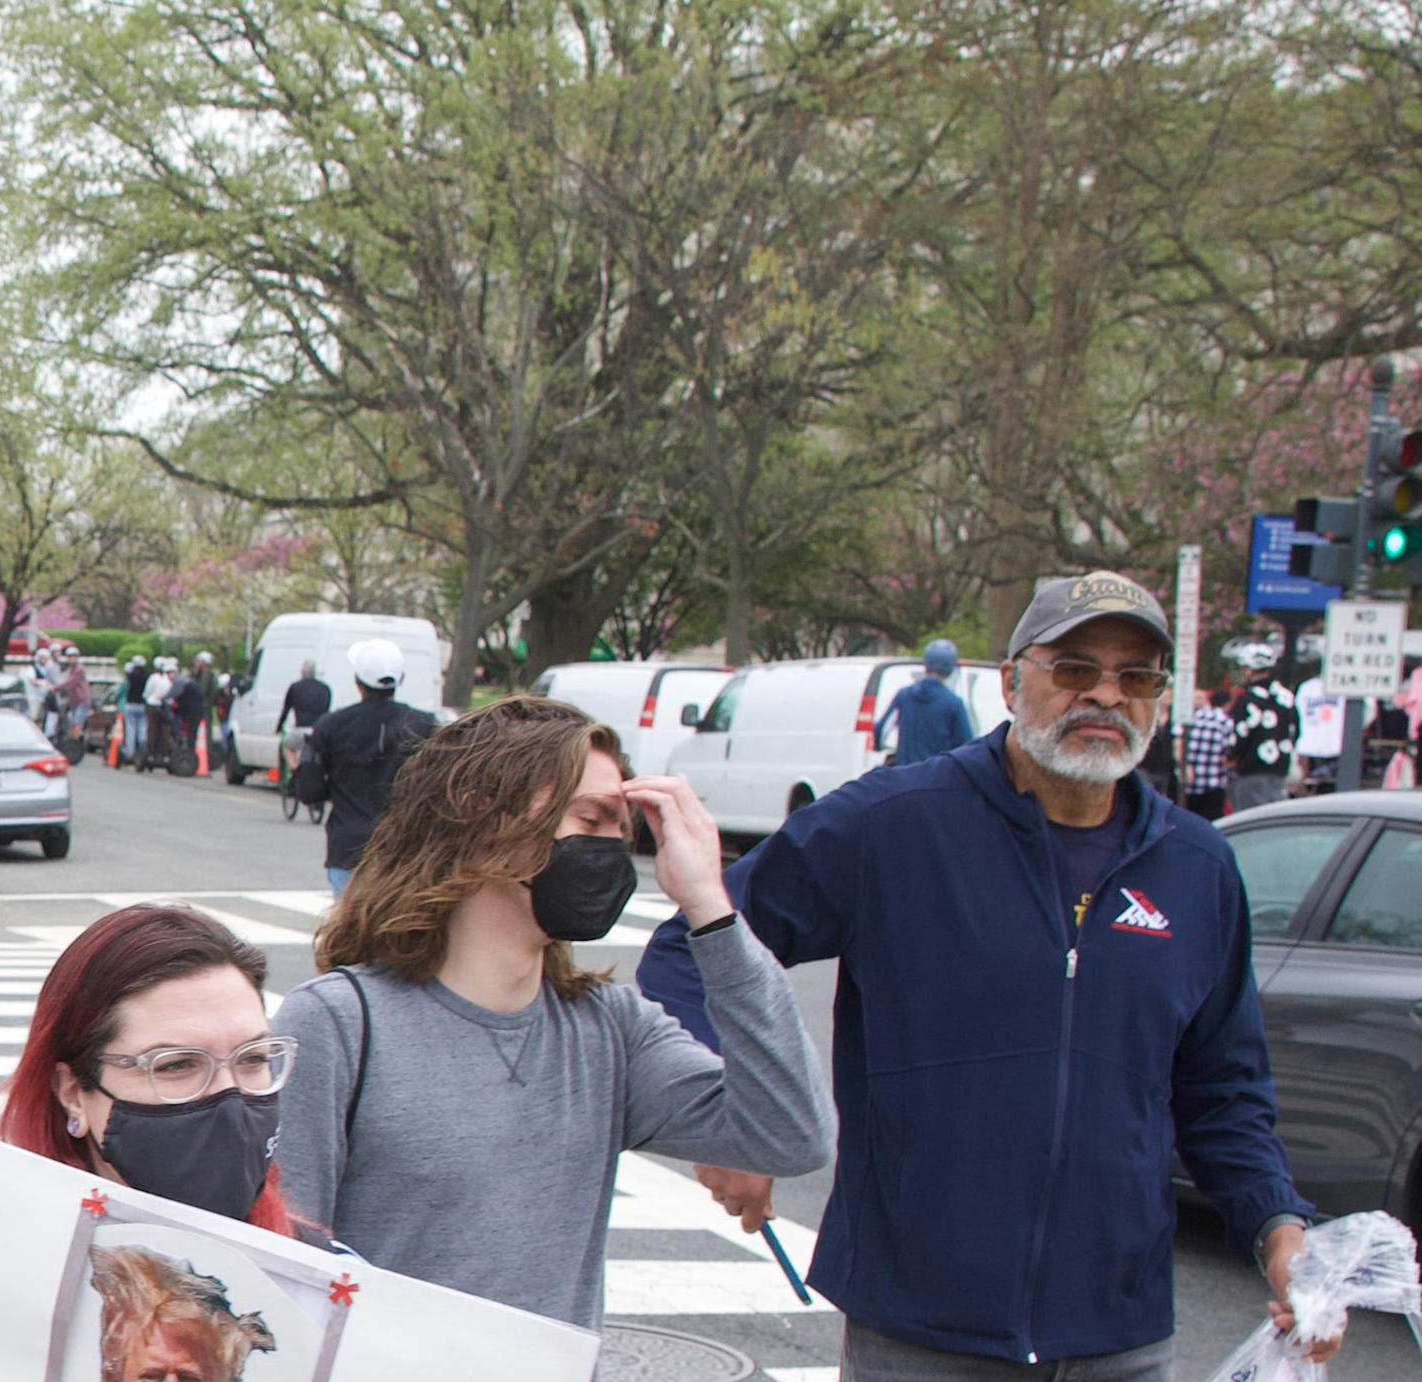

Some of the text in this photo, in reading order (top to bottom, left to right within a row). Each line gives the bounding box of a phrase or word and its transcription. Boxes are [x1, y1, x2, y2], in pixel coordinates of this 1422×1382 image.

[1355, 610, 1377, 623] NO
[1344, 633, 1387, 645] TURN
[1332, 654, 1395, 667] ON RED
